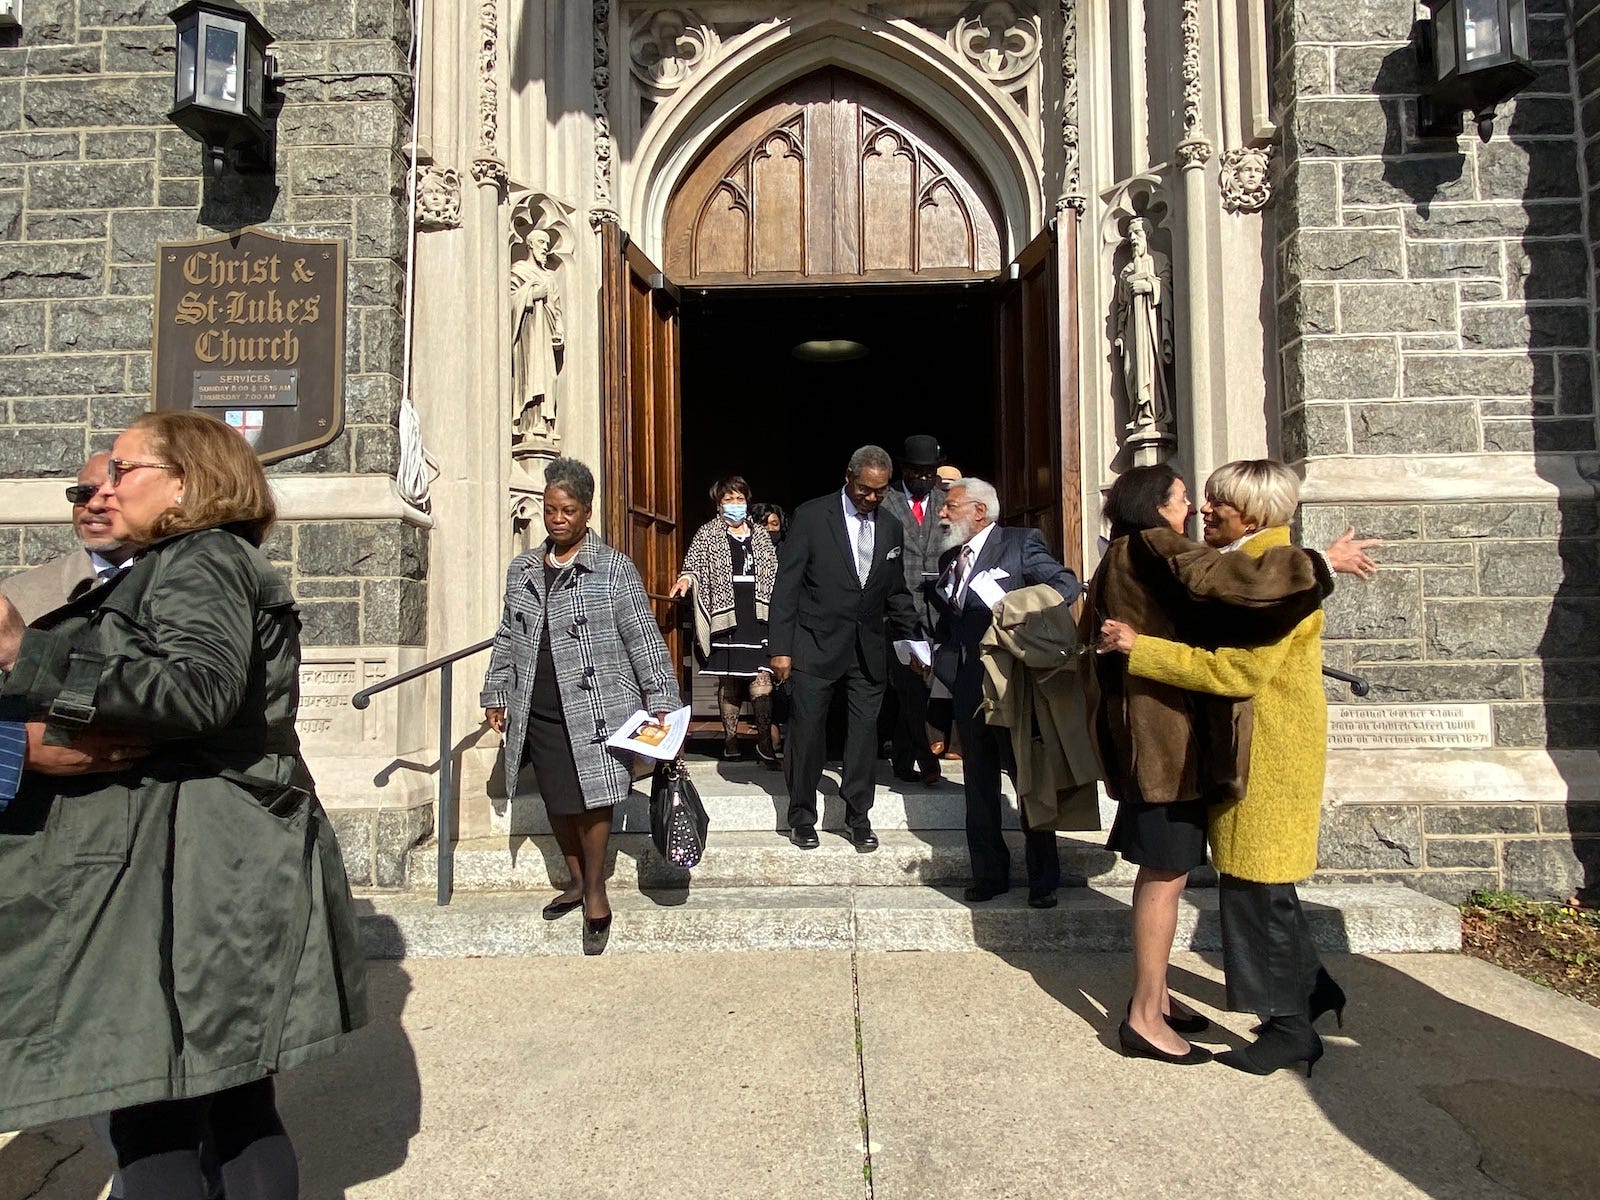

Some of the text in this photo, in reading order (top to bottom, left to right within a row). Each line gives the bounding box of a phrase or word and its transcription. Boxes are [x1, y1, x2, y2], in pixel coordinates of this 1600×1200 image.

[182, 250, 317, 289] Christ &
[194, 328, 300, 367] Church
[219, 374, 271, 383] SERVICES
